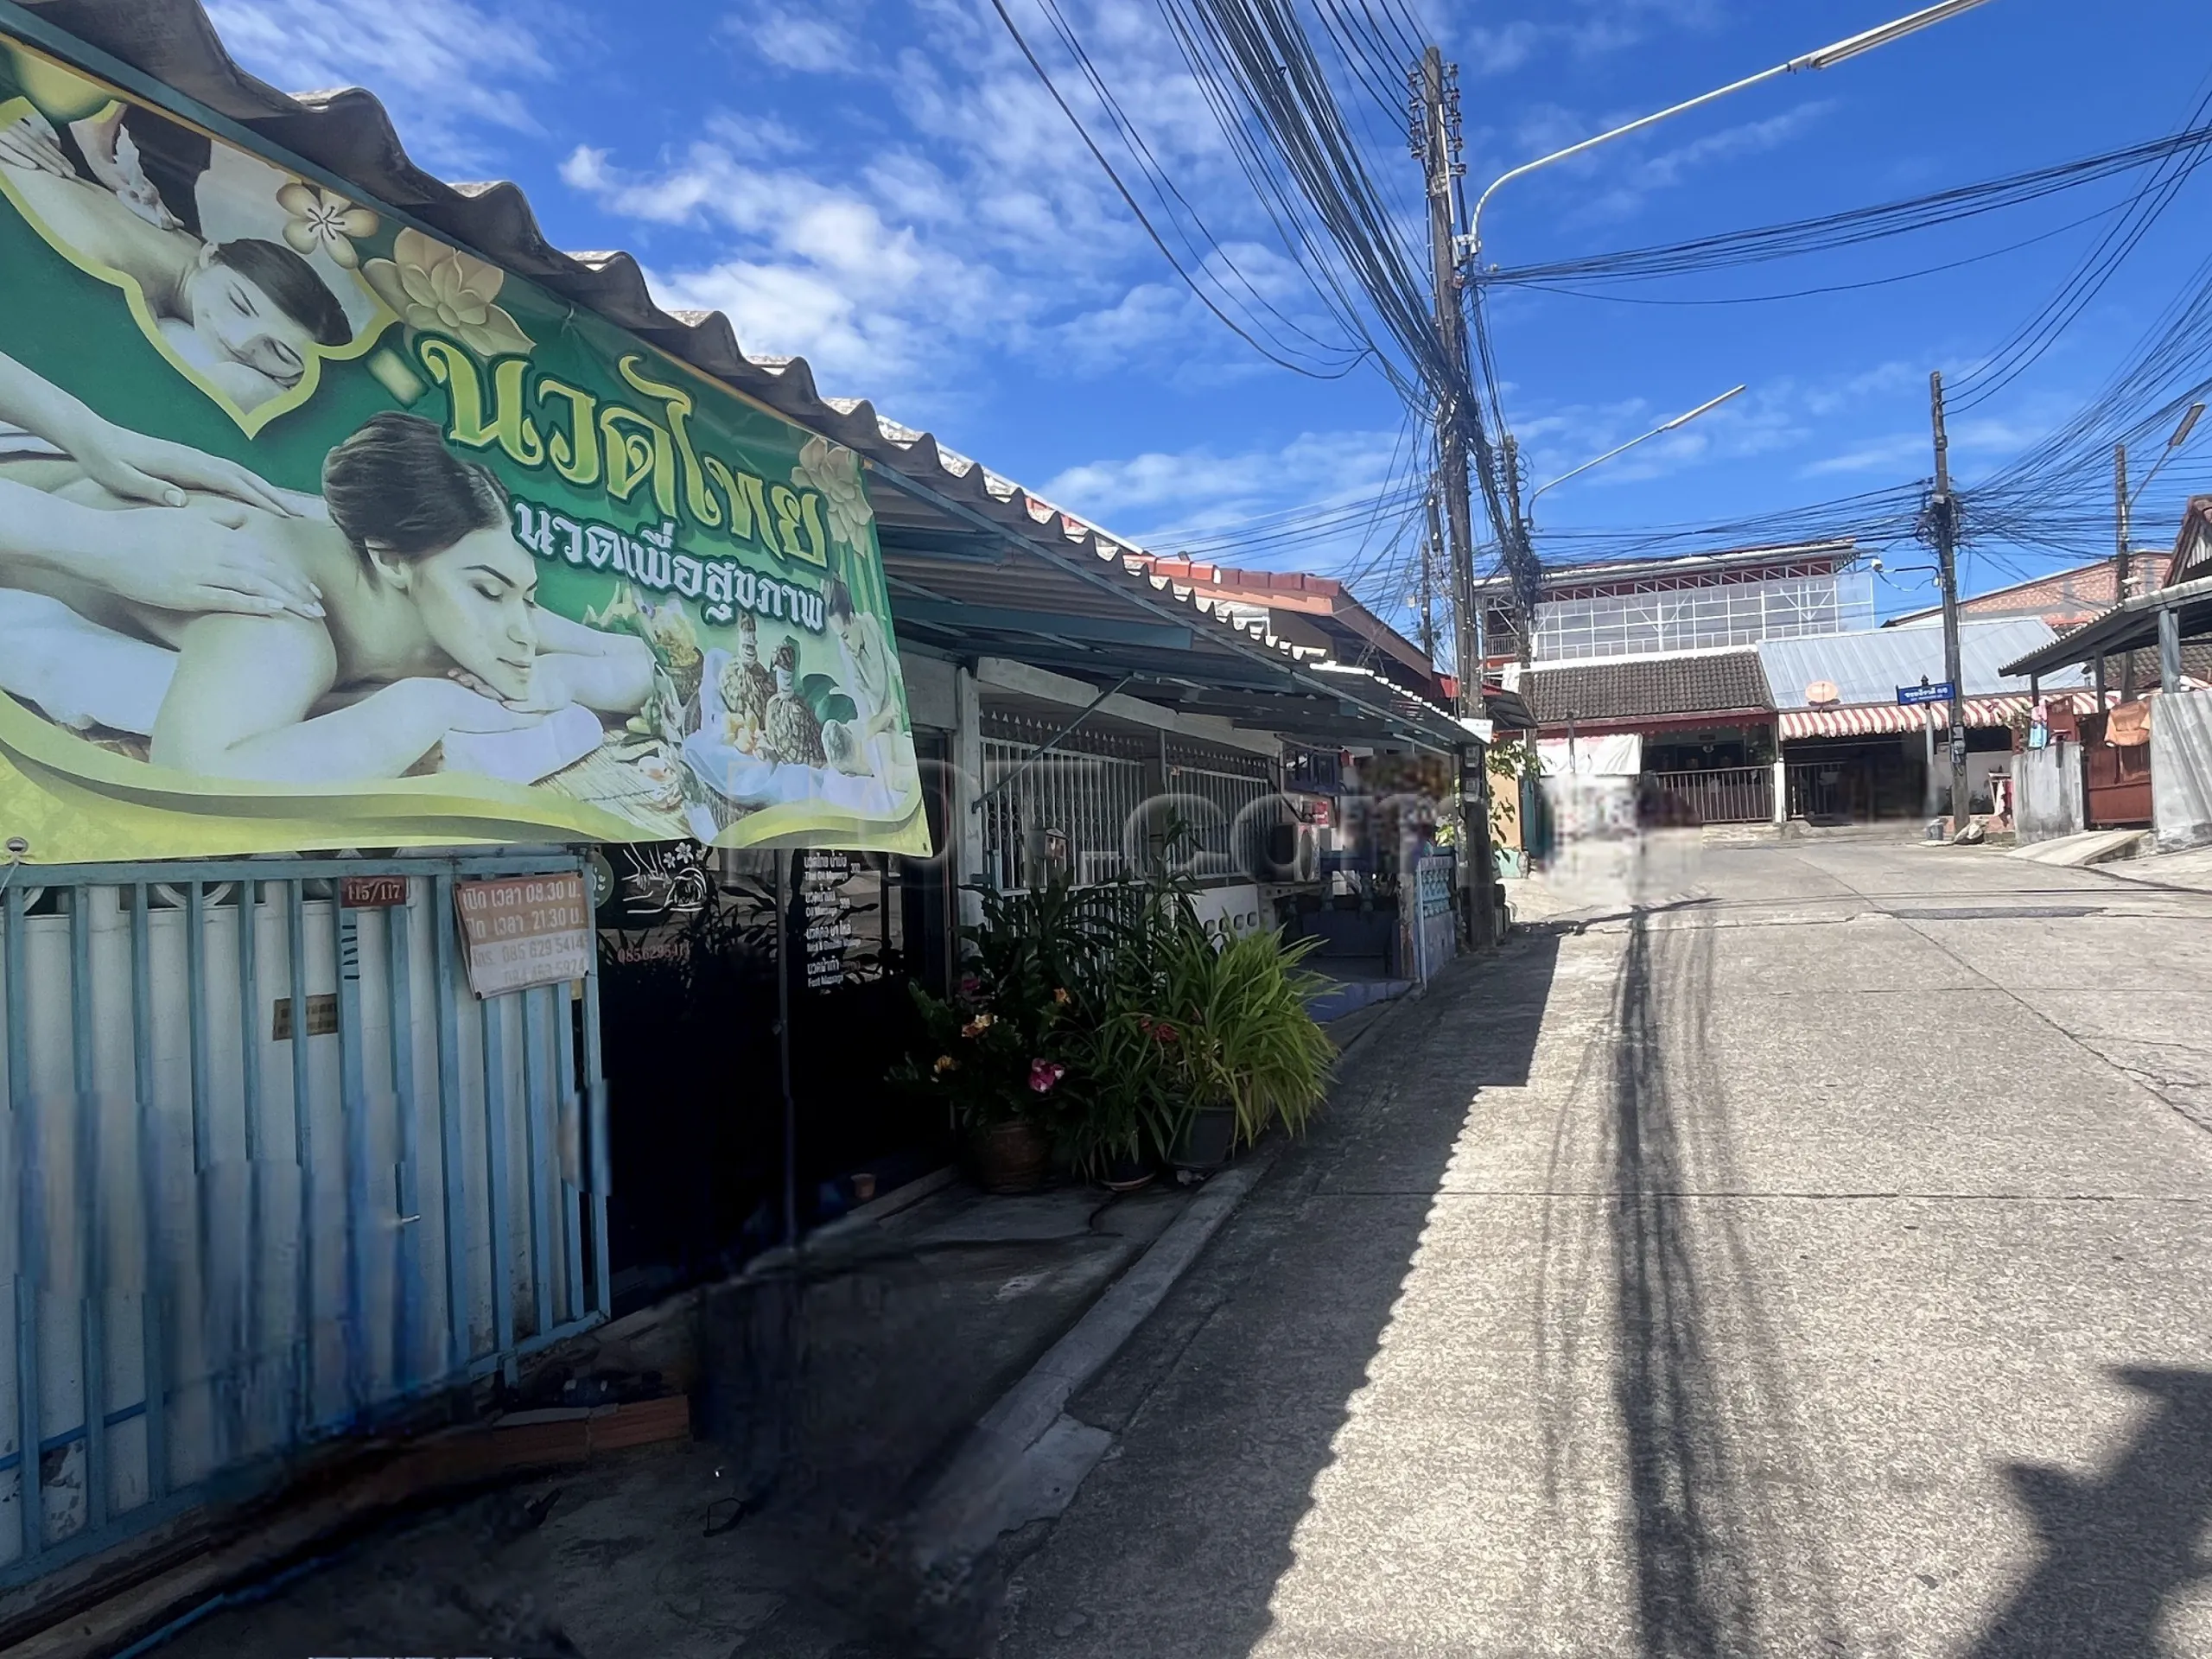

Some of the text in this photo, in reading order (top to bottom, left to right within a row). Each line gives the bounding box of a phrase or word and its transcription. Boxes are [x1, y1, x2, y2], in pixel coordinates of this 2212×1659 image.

[421, 339, 829, 569] นวดไทย
[514, 502, 824, 631] นวดเพื่อสุขภาพ
[347, 882, 402, 903] 115/117
[462, 887, 487, 911] เปิด
[491, 887, 522, 907] เวลา
[525, 880, 564, 903] 08.30
[493, 915, 524, 936] เวลา
[531, 906, 566, 930] 21.30
[501, 943, 526, 963] 085
[529, 938, 552, 958] 629
[554, 934, 587, 954] 5414
